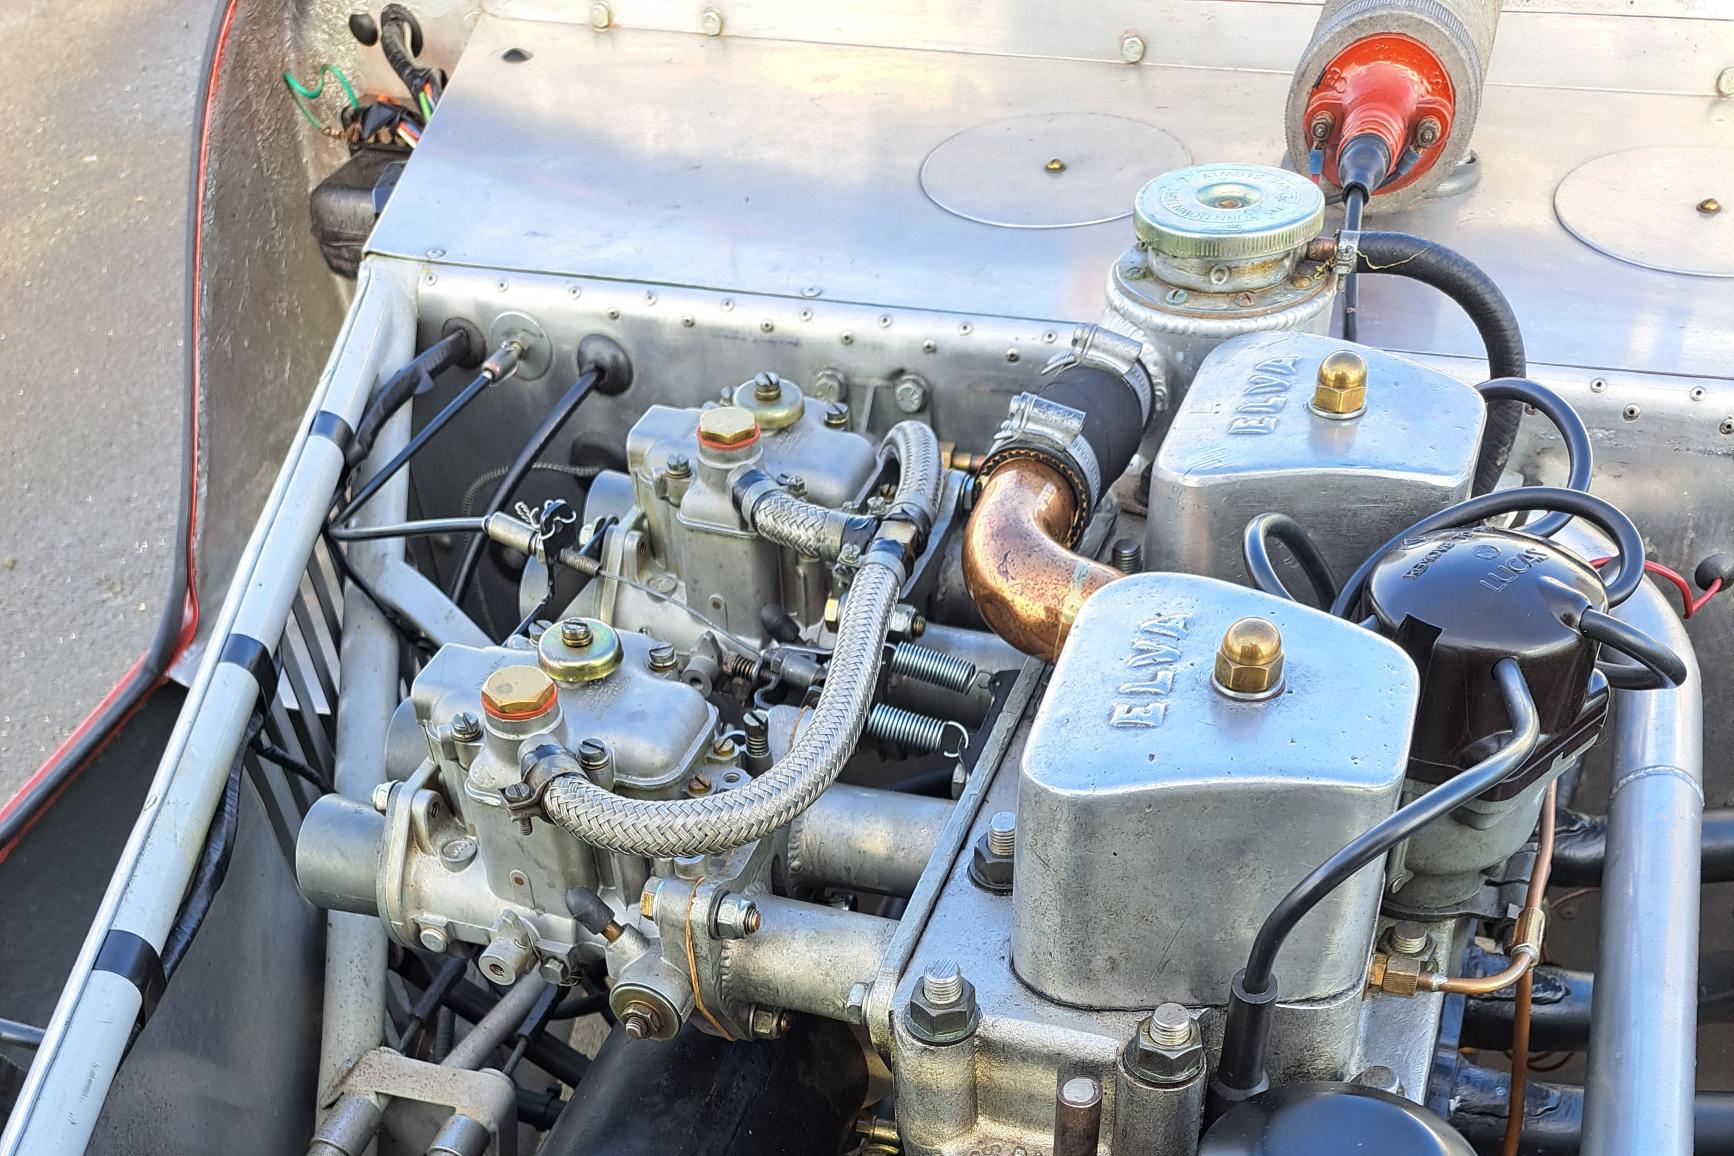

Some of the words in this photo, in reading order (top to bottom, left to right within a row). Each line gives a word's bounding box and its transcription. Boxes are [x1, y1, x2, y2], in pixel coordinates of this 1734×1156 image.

[1228, 354, 1299, 435] ELVA
[1402, 541, 1456, 581] REMOVE
[1479, 547, 1550, 593] LUCAS
[1108, 611, 1192, 729] ELVA
